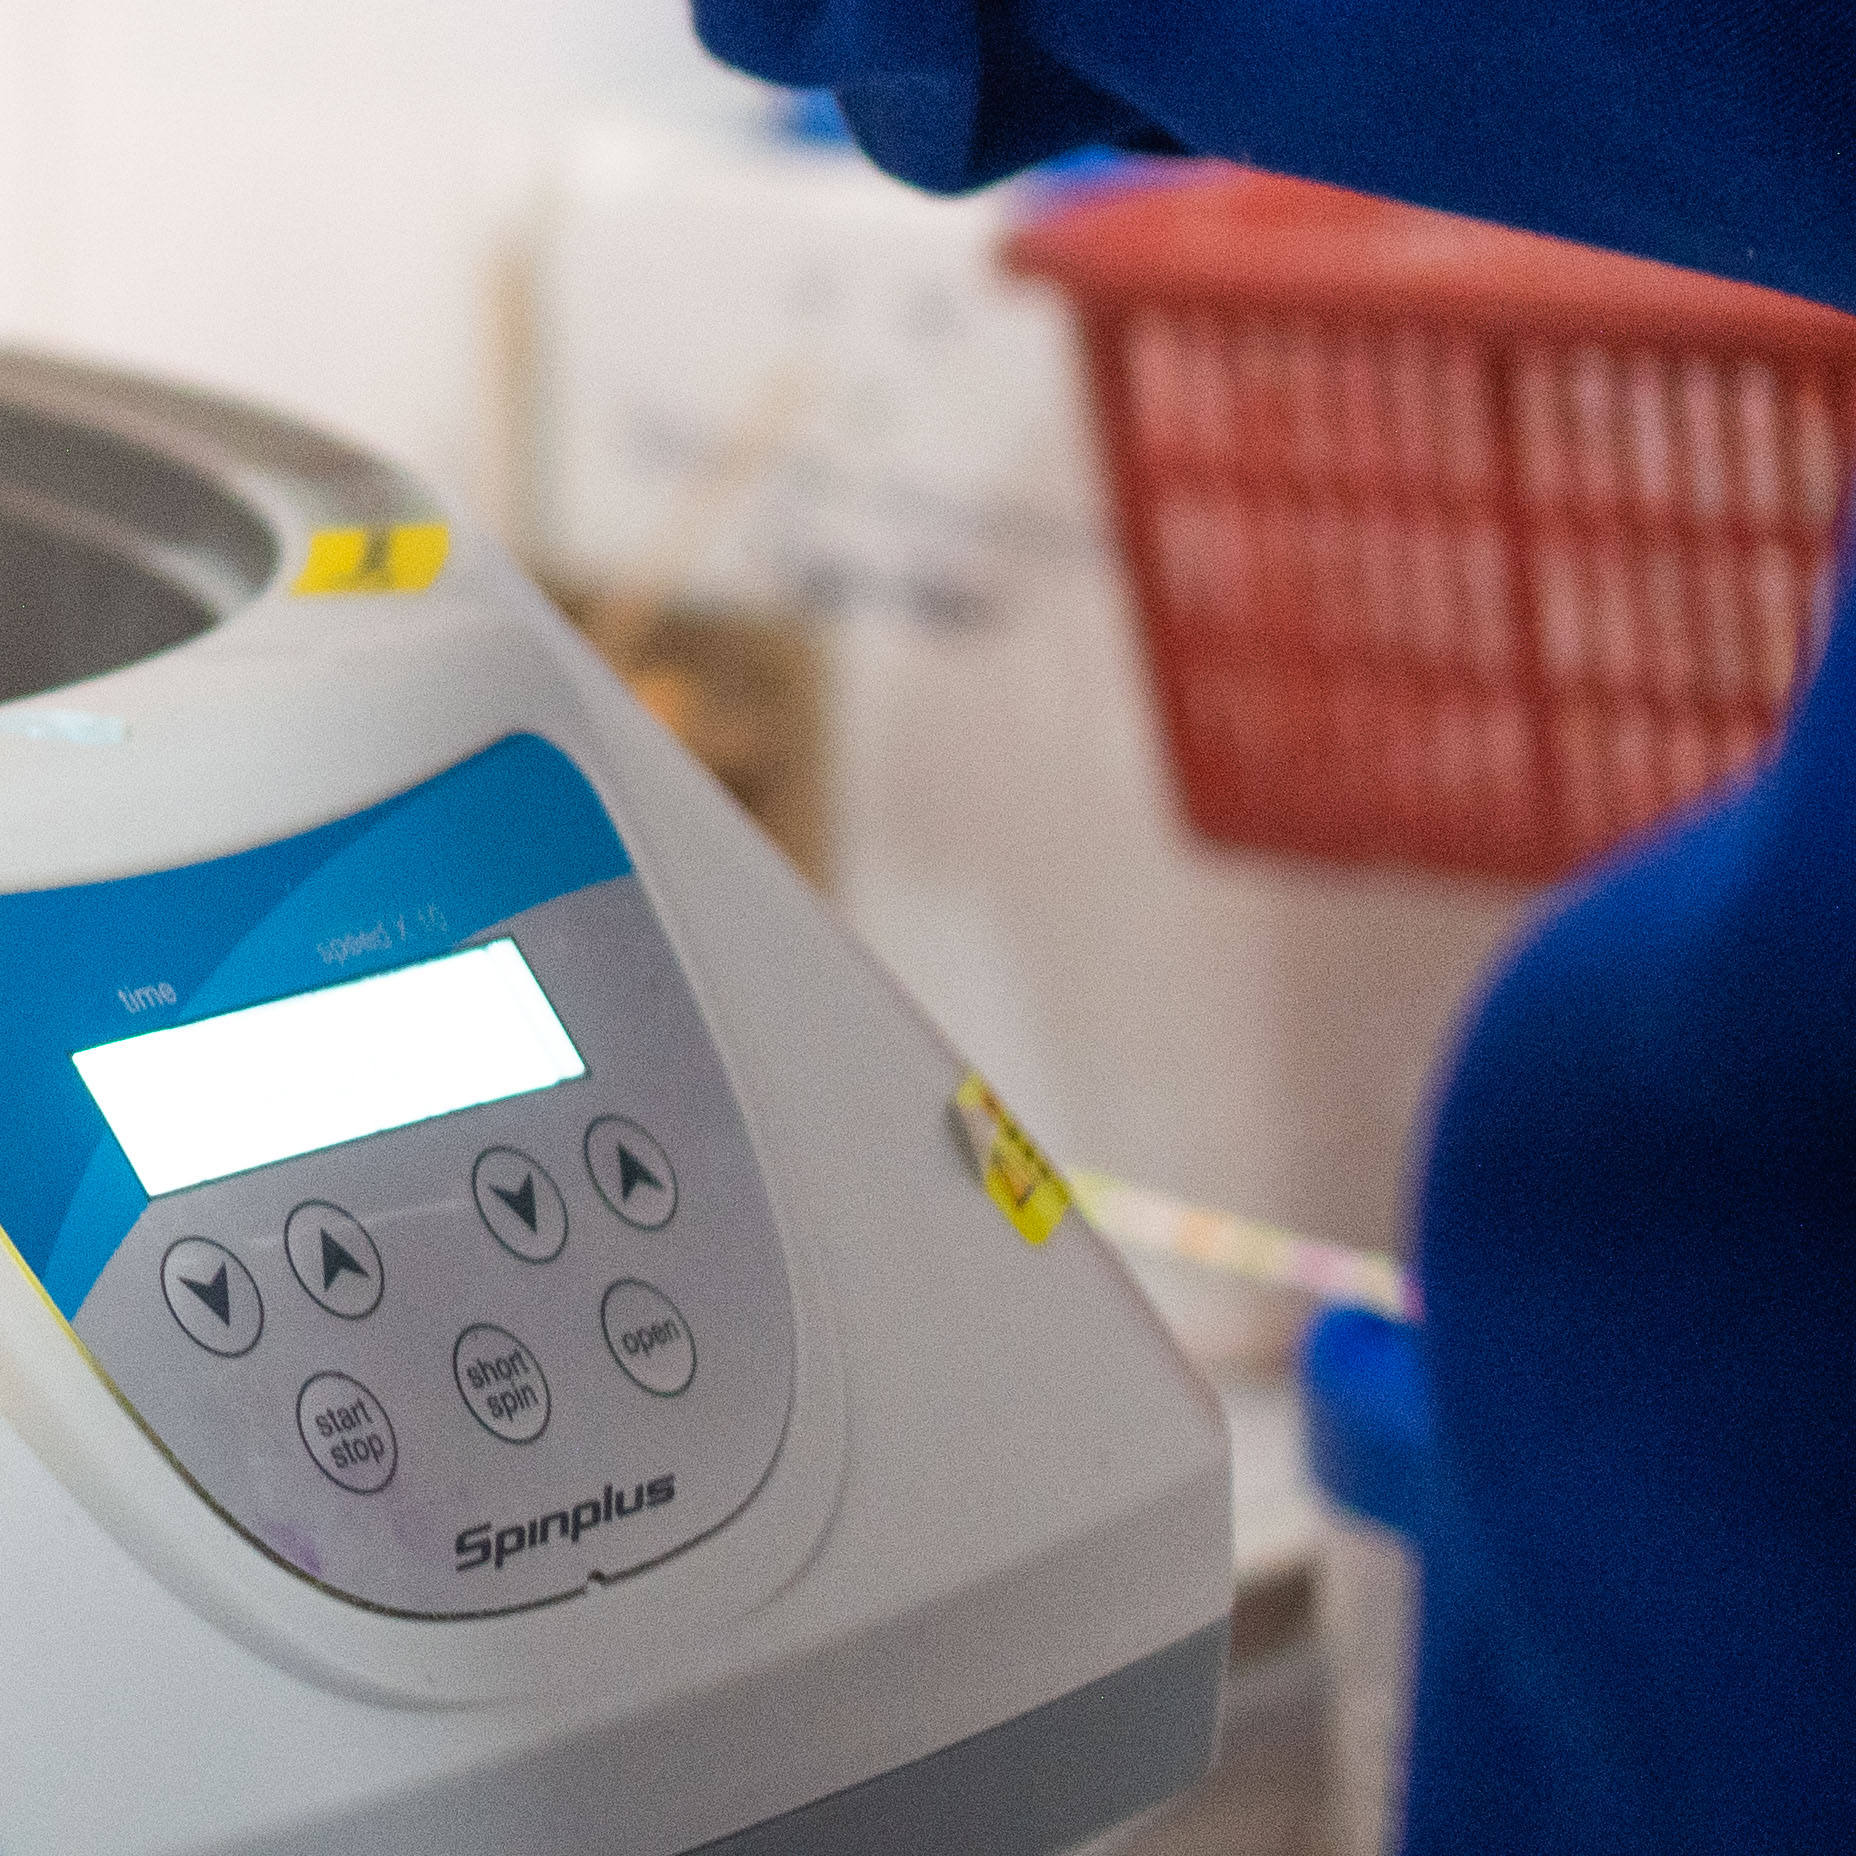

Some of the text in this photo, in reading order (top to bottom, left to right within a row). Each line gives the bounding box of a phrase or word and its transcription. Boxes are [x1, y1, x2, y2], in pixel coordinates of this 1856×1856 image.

[317, 919, 392, 966] speed
[117, 982, 178, 1015] time
[621, 1317, 680, 1358] open
[466, 1348, 531, 1390] short
[315, 1397, 374, 1438] start
[487, 1380, 540, 1422] spin
[330, 1432, 386, 1470] stop
[454, 1473, 678, 1572] Spinplus
